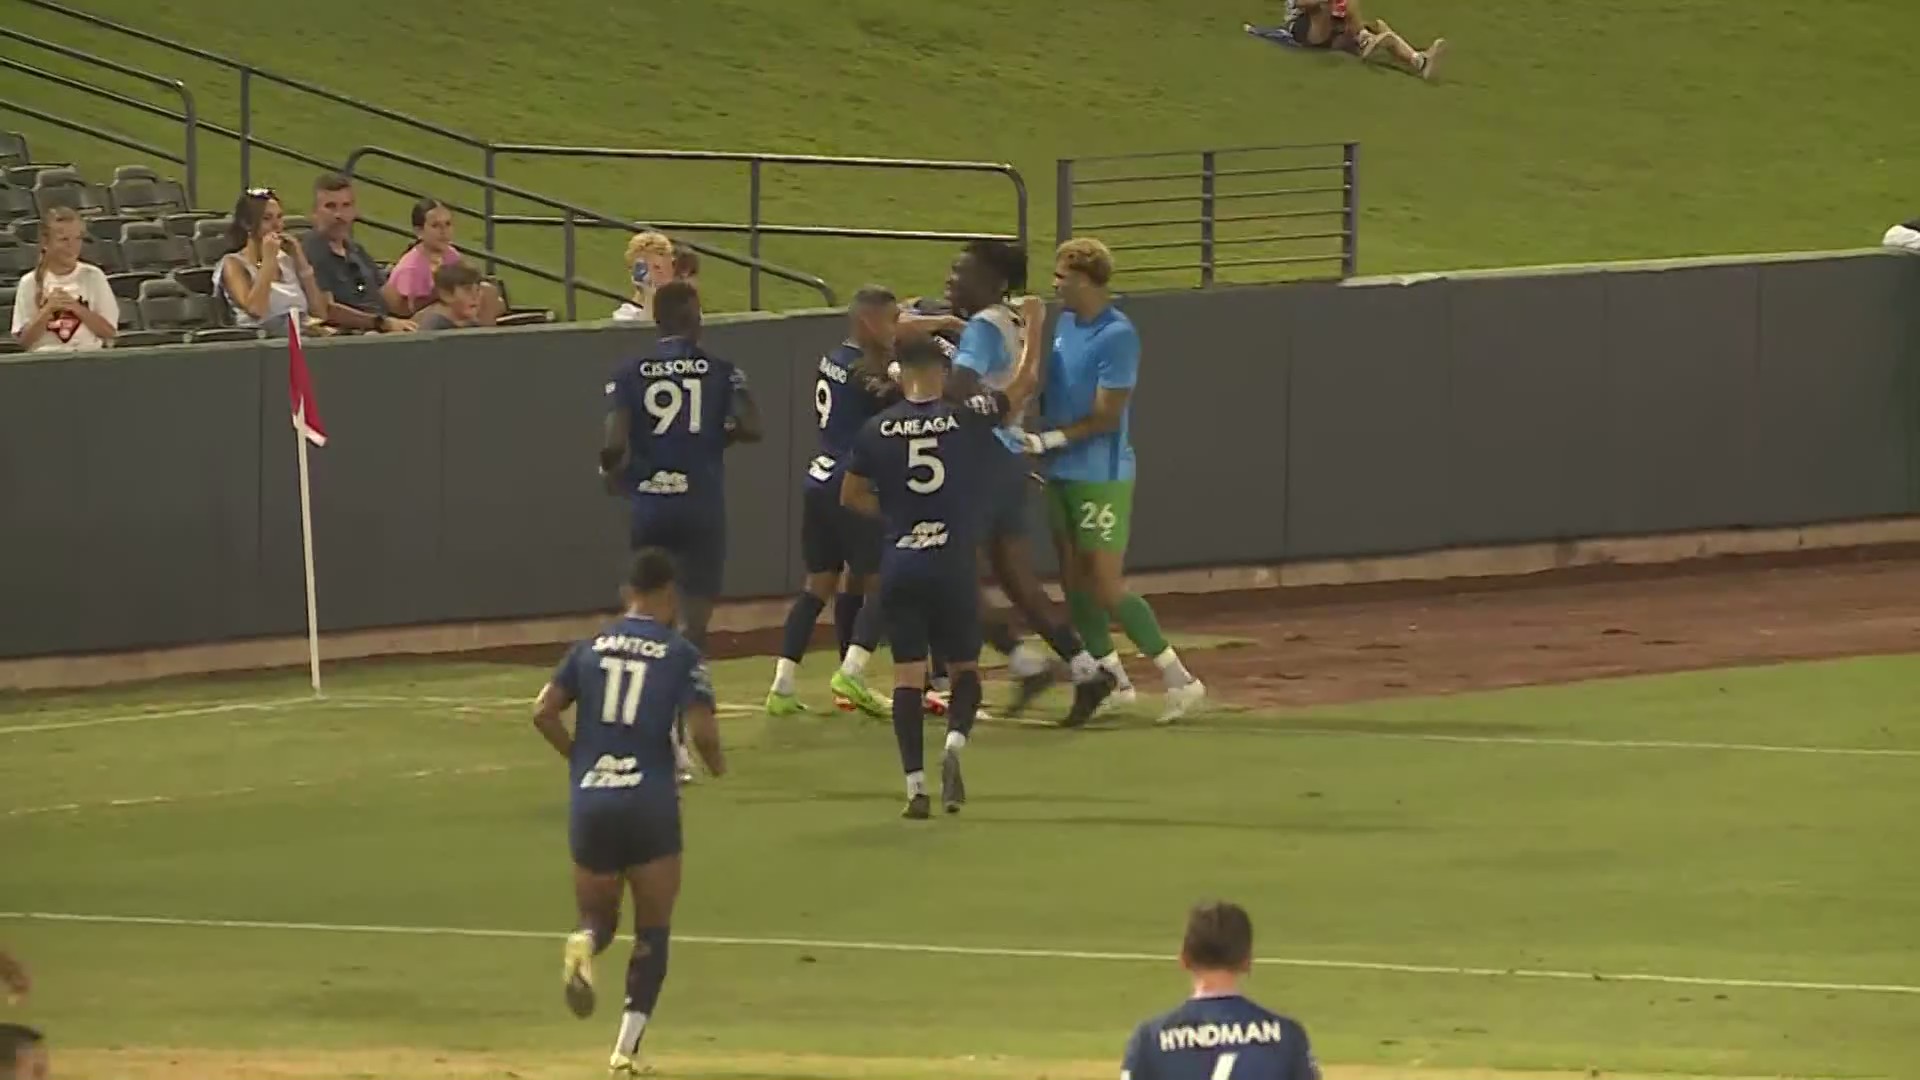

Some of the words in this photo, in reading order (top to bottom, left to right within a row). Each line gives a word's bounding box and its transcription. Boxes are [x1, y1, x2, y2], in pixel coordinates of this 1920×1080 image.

[640, 357, 709, 377] CISSOKO
[643, 379, 701, 435] 91
[815, 379, 833, 430] 9
[880, 415, 960, 438] CAREAGA
[906, 438, 945, 494] 5
[1079, 501, 1117, 530] 26
[592, 634, 670, 659] SANTOS
[599, 656, 648, 725] 11
[1159, 1019, 1282, 1052] HYNDMAN
